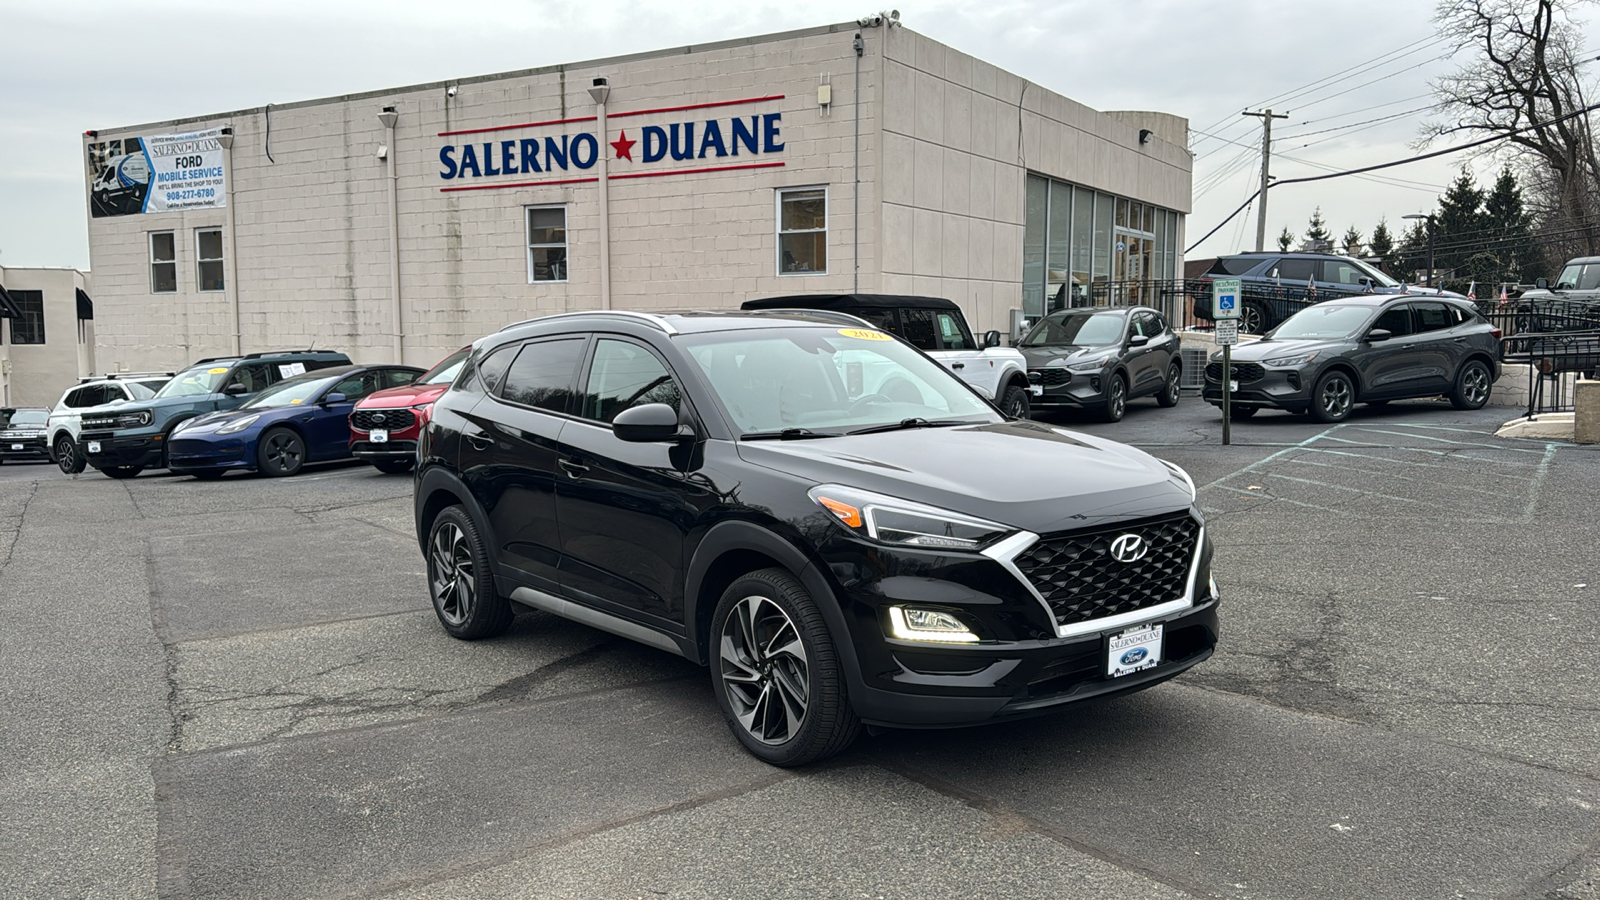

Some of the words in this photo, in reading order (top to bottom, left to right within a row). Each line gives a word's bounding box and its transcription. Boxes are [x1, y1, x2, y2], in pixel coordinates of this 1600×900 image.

[153, 143, 188, 156] SALERNO
[192, 139, 220, 152] DUANE
[439, 132, 599, 179] SALERNO
[641, 112, 785, 163] DUANE
[176, 155, 202, 169] FORD
[158, 170, 188, 182] MOBILE
[189, 167, 223, 180] SERVICE
[167, 188, 215, 200] 908-277-6780
[850, 331, 883, 339] 2021
[780, 594, 806, 632] POTENZA
[1111, 636, 1138, 650] SALERNO
[1140, 630, 1161, 642] DUANE
[1125, 650, 1144, 663] Ford
